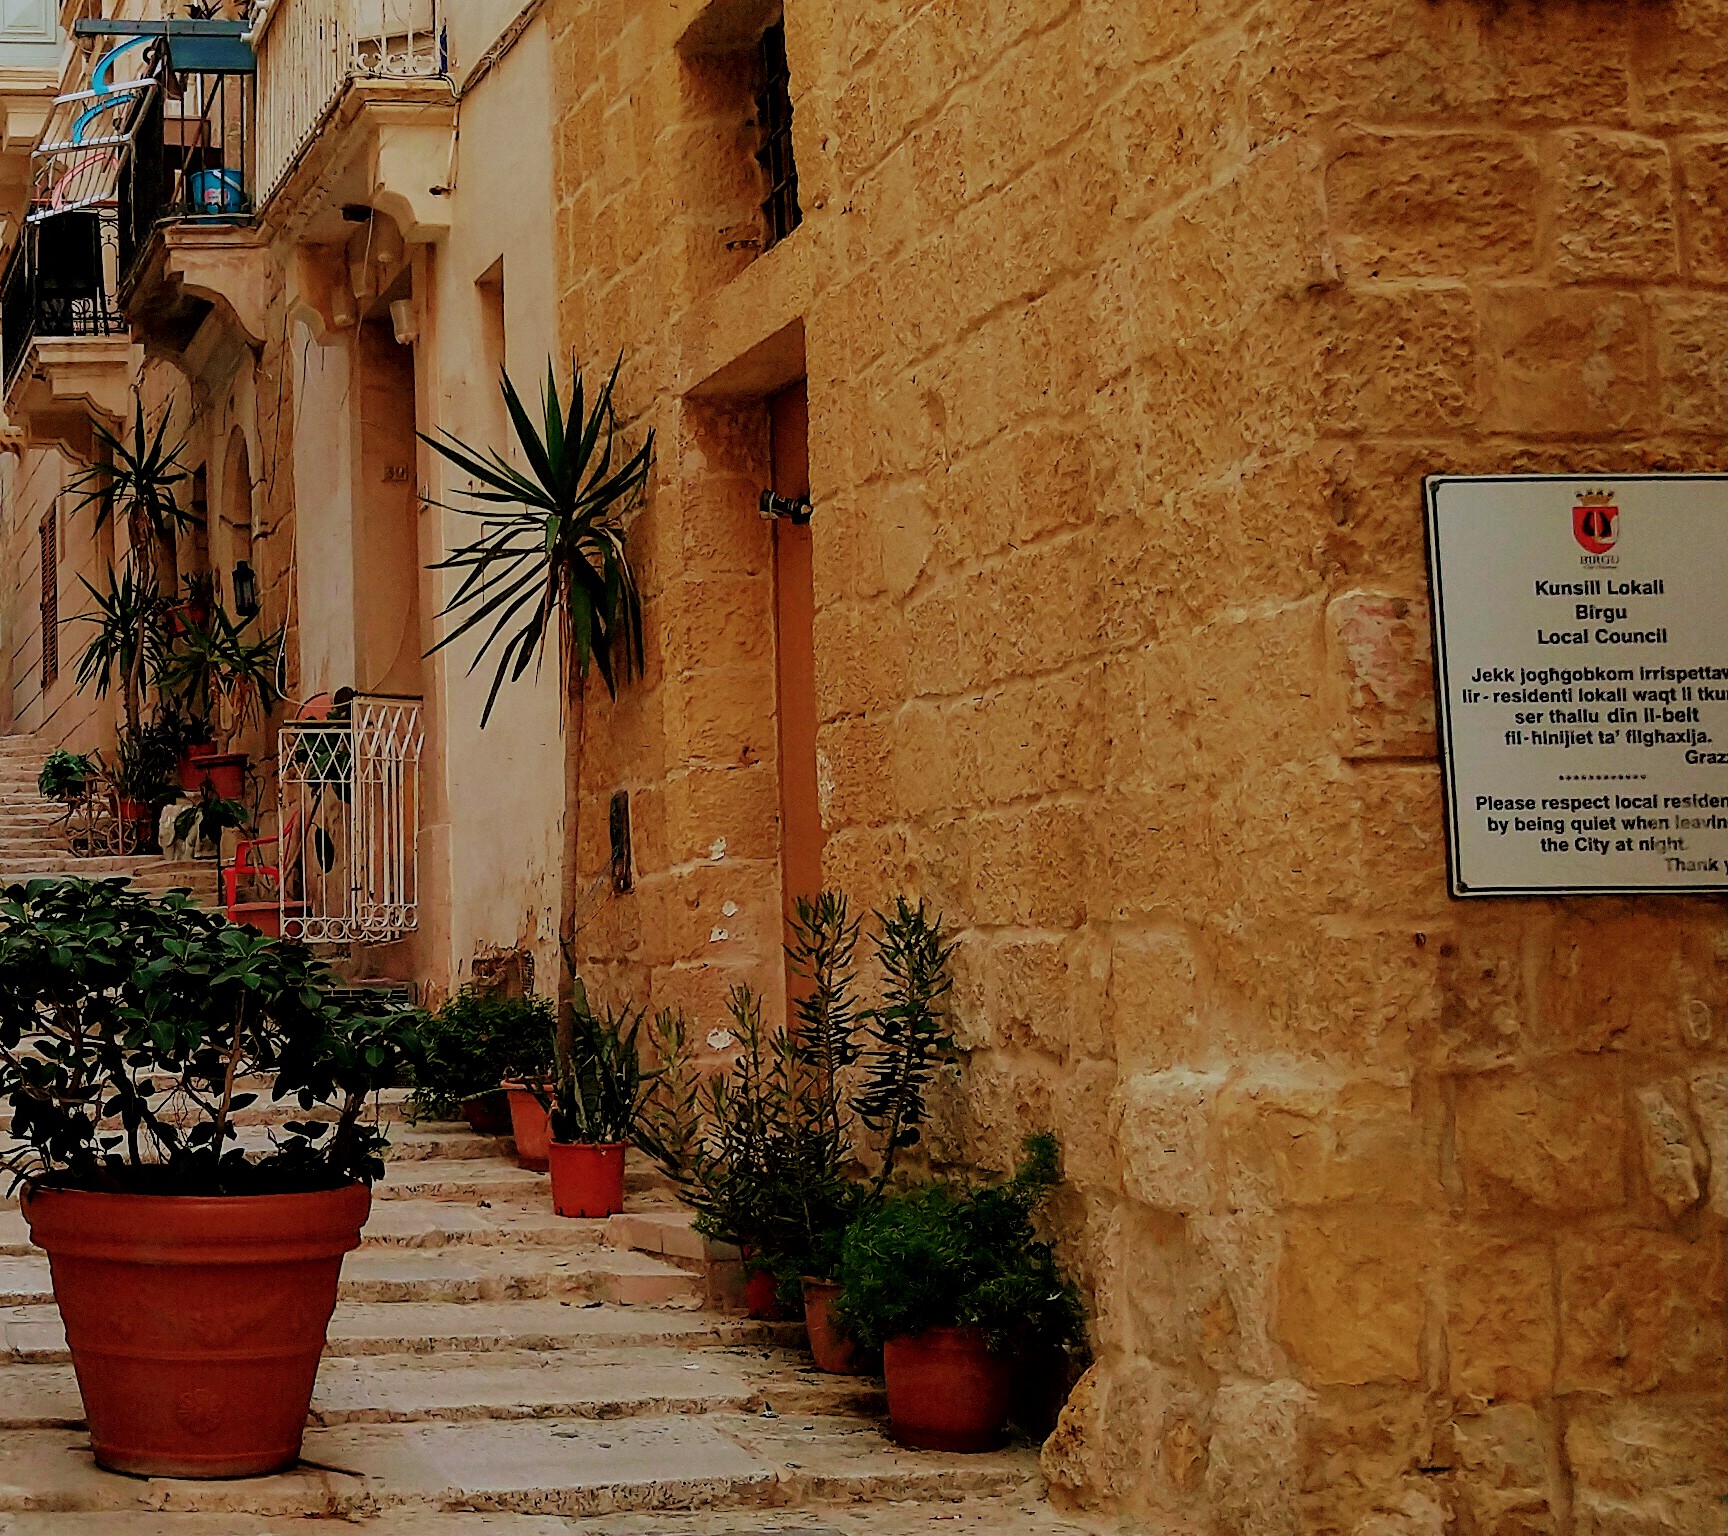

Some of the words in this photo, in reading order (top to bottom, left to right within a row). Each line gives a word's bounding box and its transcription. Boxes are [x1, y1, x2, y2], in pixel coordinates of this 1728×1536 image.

[1535, 579, 1601, 596] Kunsill
[1607, 579, 1664, 596] Lokali
[1575, 604, 1628, 624] Birgu
[1537, 628, 1589, 645] Local
[1594, 627, 1668, 644] Council
[1471, 667, 1515, 683] Jekk
[1578, 687, 1628, 703] lokali
[1632, 687, 1678, 706] waqt
[1514, 712, 1544, 725] ser
[1607, 707, 1638, 724] din
[1475, 795, 1536, 811] Please
[1541, 795, 1611, 814] respect
[1615, 793, 1658, 810] local
[1487, 816, 1510, 836] by
[1514, 816, 1565, 835] being
[1570, 815, 1617, 835] quiet
[1620, 815, 1670, 831] when
[1540, 837, 1570, 853] the
[1574, 836, 1611, 856] City
[1615, 837, 1634, 852] at
[1665, 857, 1719, 872] Thank
